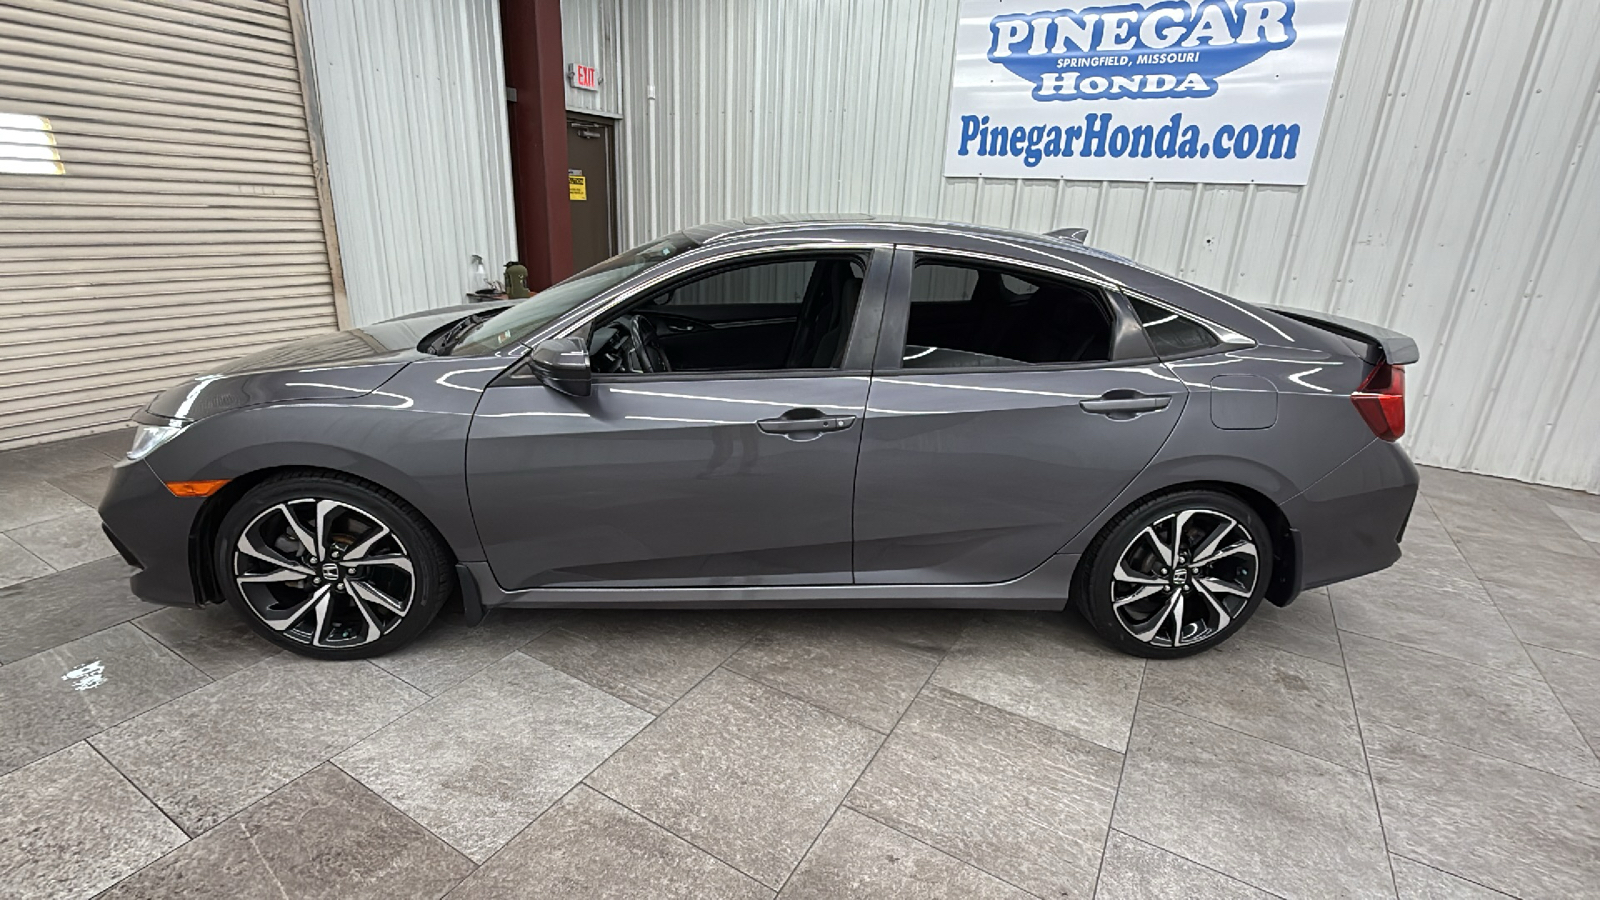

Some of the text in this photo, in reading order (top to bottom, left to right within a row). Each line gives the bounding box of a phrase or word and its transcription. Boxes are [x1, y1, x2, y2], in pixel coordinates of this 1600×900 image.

[993, 1, 1289, 57] PINEGAR
[1056, 52, 1200, 69] SPRINGFIELD, MISSOURI
[577, 65, 596, 87] EXIT
[1037, 72, 1211, 96] HONDA
[958, 113, 1301, 168] PinegarHonda.com
